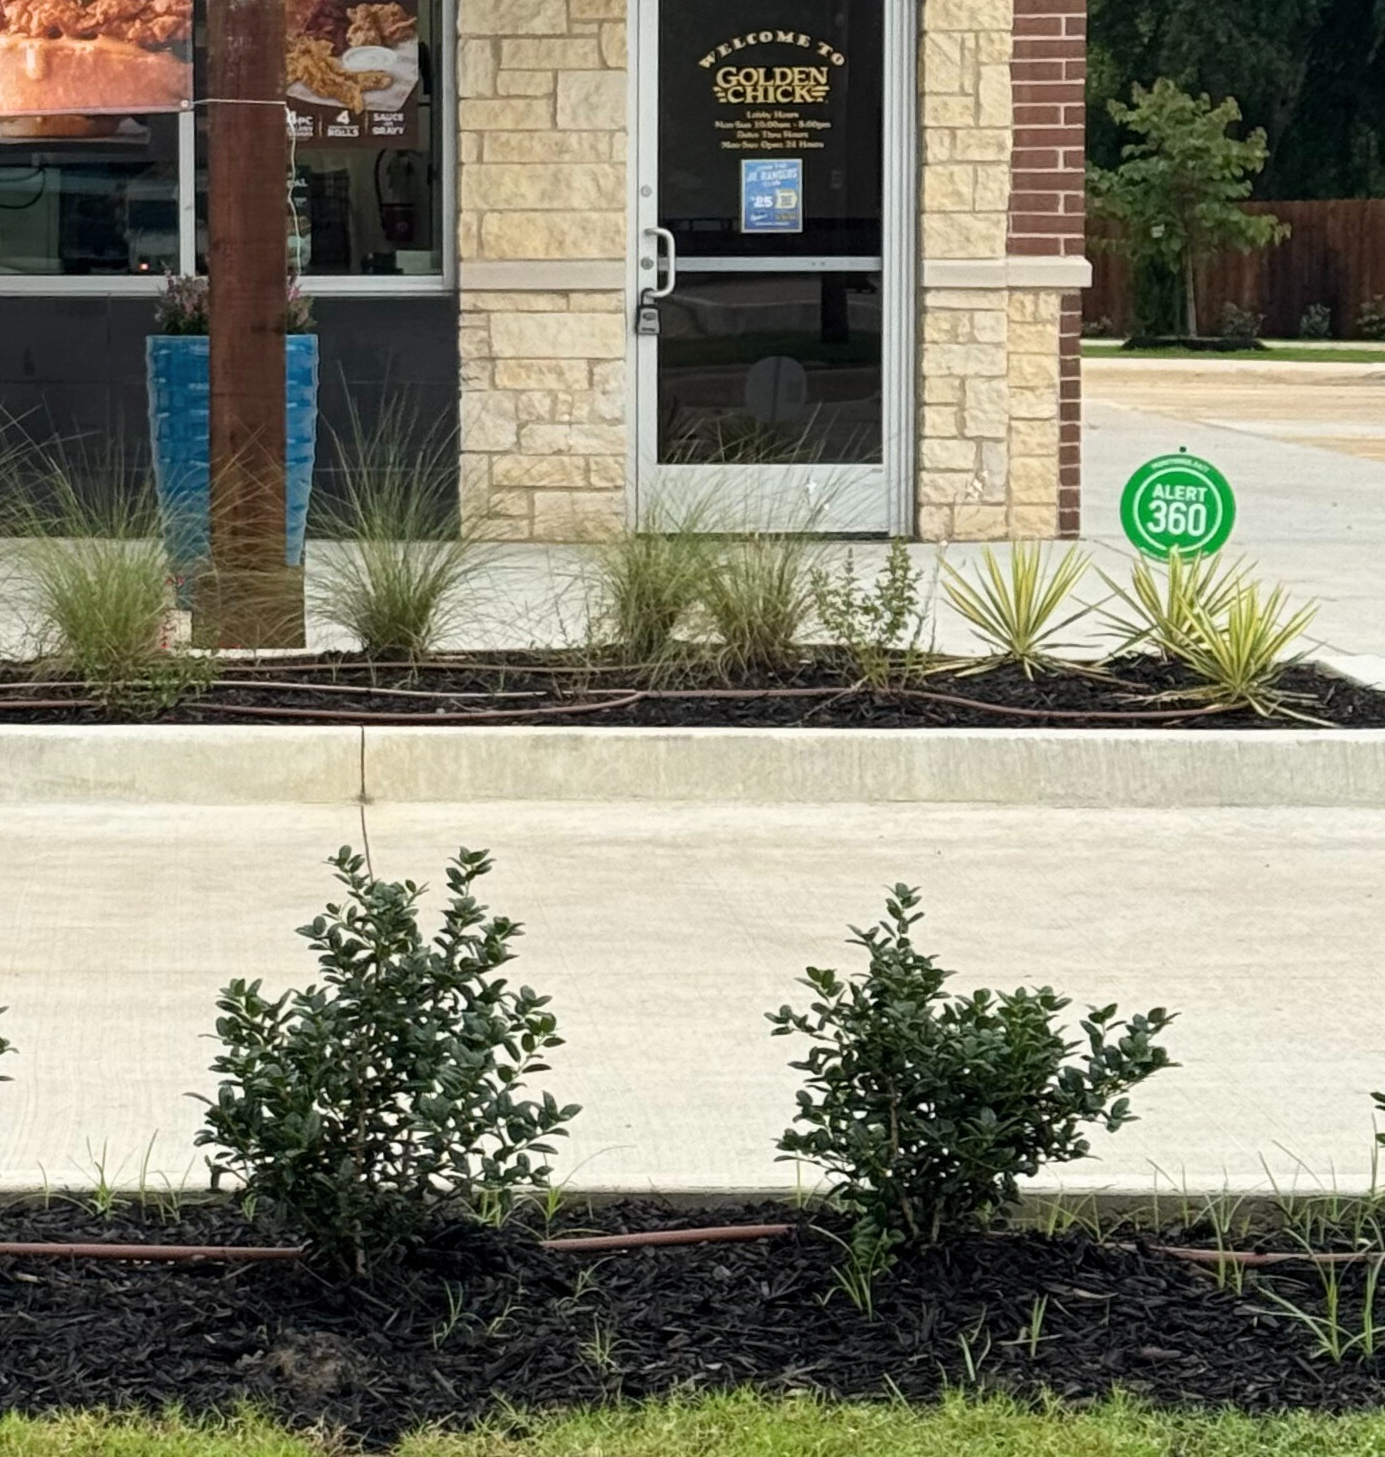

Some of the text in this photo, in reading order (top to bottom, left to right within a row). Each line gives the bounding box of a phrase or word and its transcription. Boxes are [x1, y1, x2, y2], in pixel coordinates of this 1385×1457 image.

[698, 29, 847, 70] WELCOME TO
[715, 66, 829, 89] GOLDEN
[727, 85, 814, 104] CHICK
[336, 110, 351, 125] 4
[373, 113, 404, 122] SAUCE
[1152, 483, 1208, 502] ALERT
[1146, 500, 1208, 537] 360
